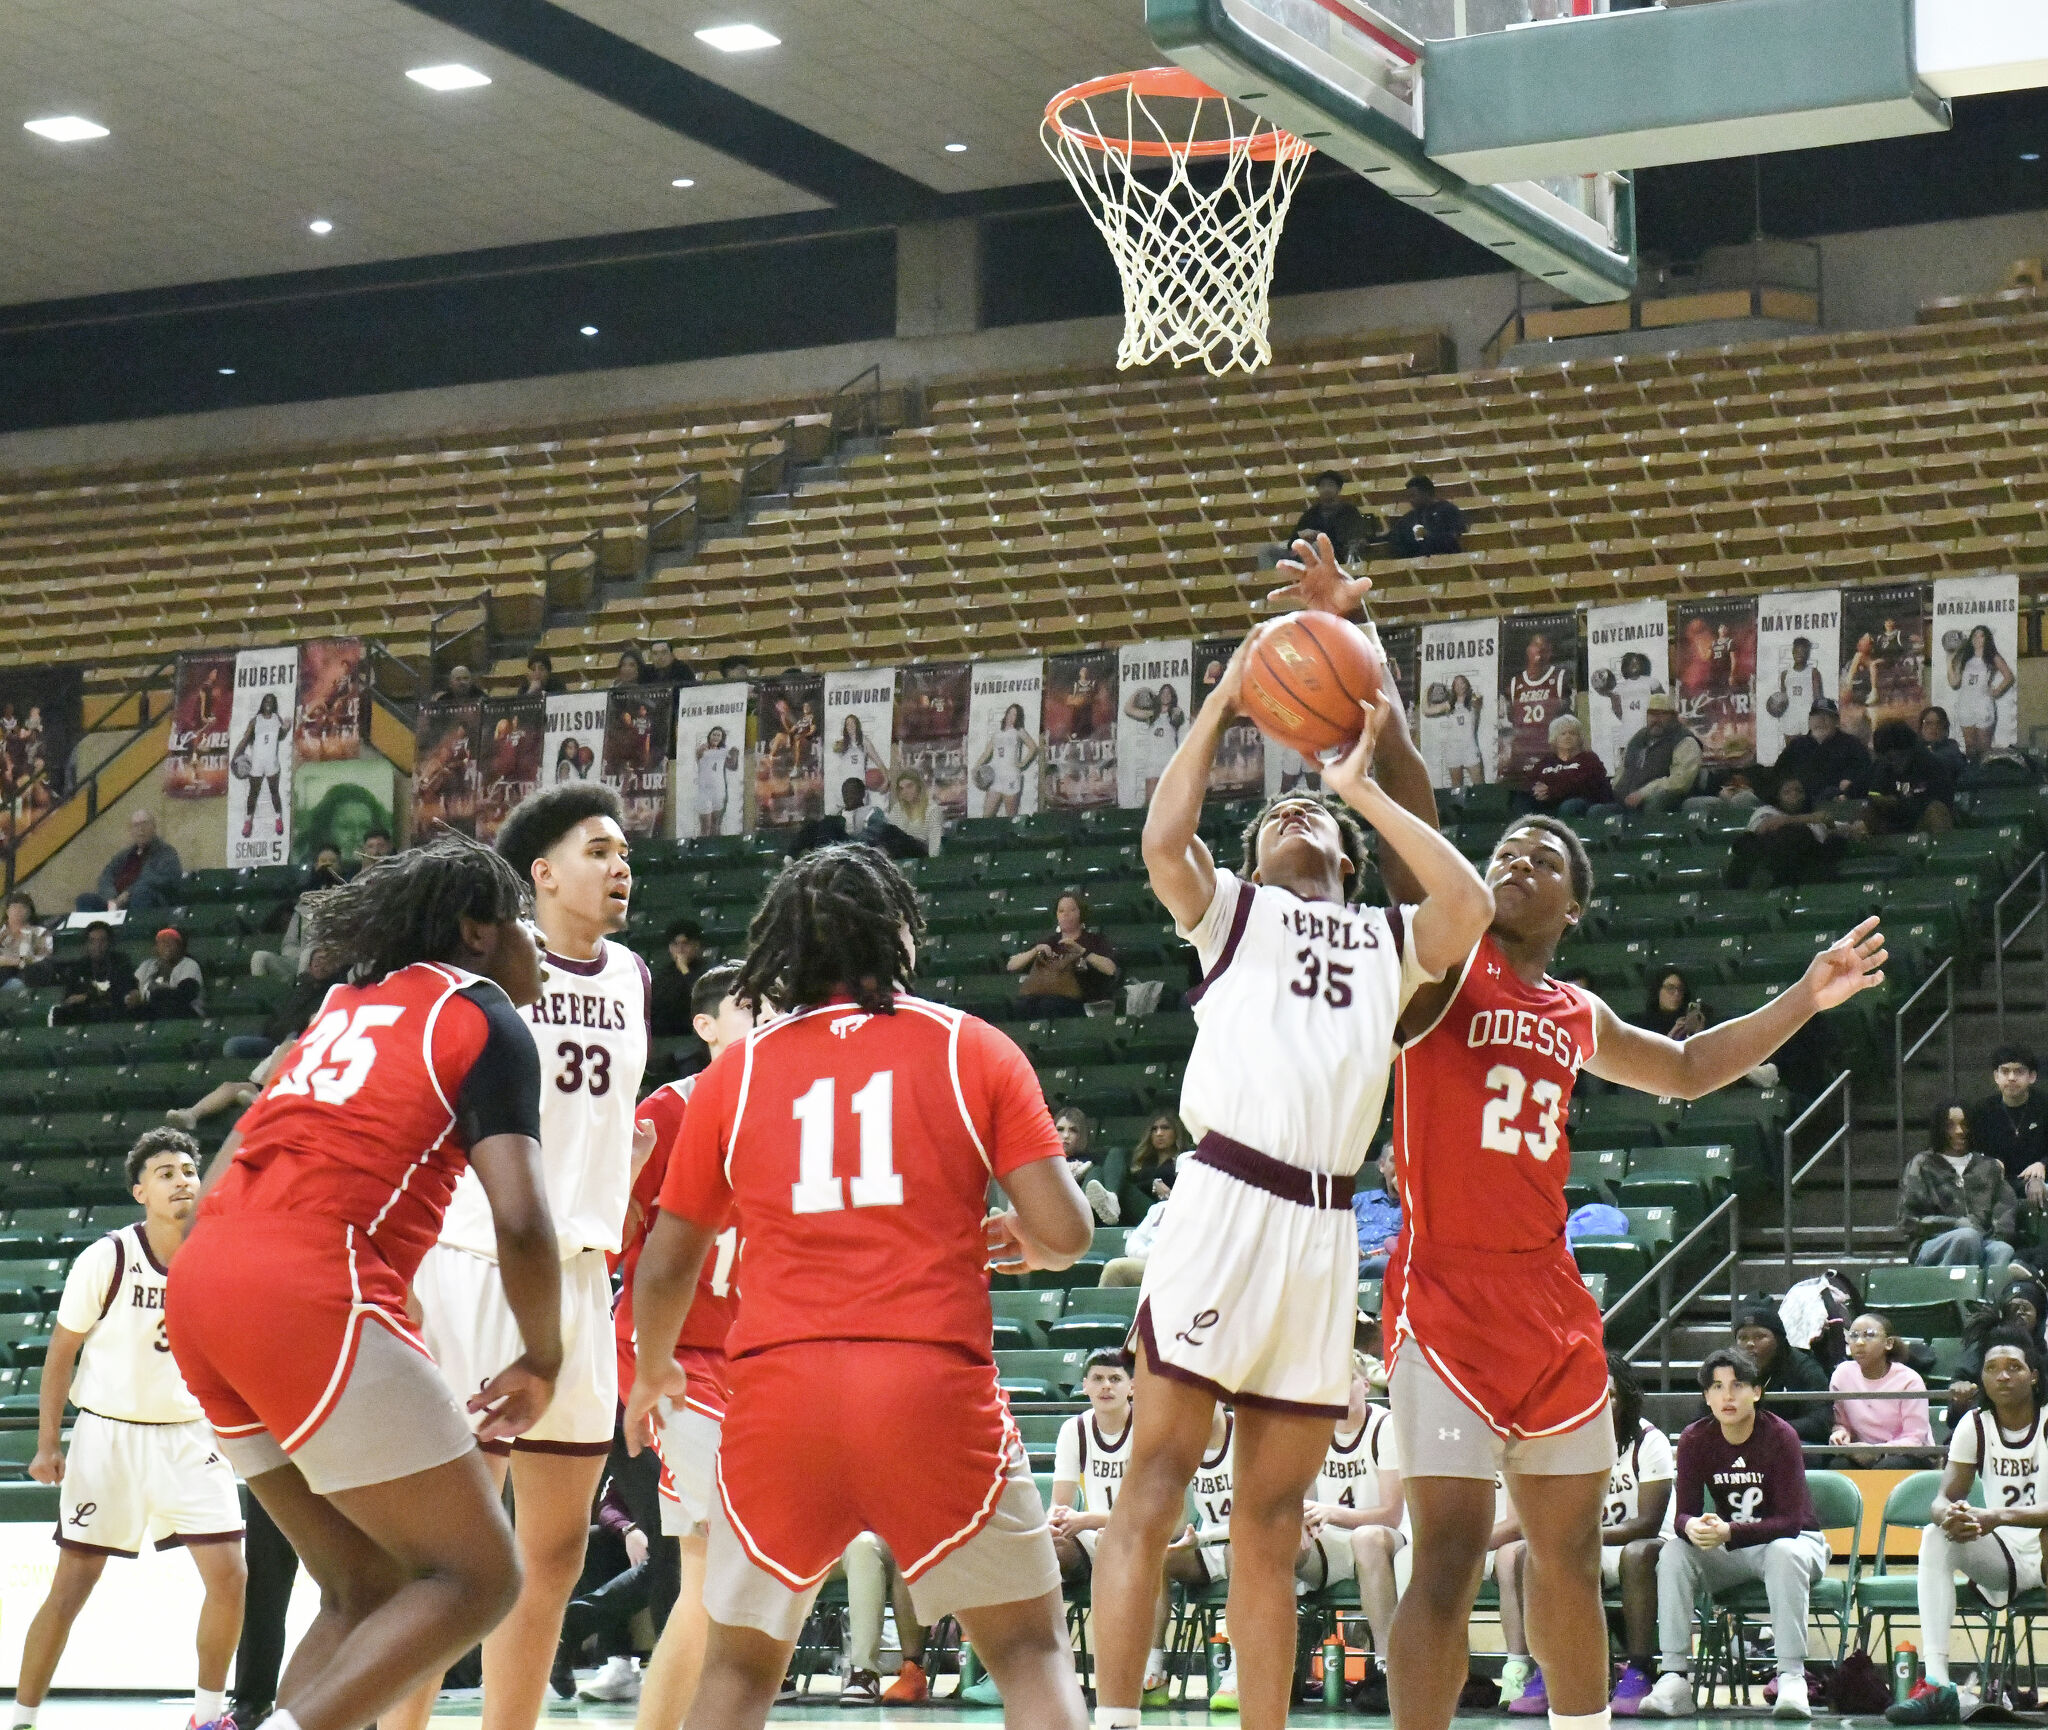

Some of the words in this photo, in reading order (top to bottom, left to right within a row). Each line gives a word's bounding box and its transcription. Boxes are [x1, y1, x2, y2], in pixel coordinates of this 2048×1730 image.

[1937, 599, 2015, 615] MANZANARES
[1592, 623, 1664, 644] ONYEMAIZU
[1761, 612, 1838, 632] MAYBERRY
[1425, 638, 1495, 661] RHOADES
[238, 665, 295, 688] HUBERT
[1122, 659, 1189, 681] PRIMERA
[828, 687, 891, 706] ERDWURM
[974, 678, 1040, 695] VANDERVEER
[545, 709, 605, 732] WILSON
[1522, 705, 1545, 723] 20
[236, 842, 267, 858] SENIOR
[272, 841, 282, 862] 5
[1291, 947, 1354, 1009] 35
[532, 992, 626, 1030] REBELS
[556, 1041, 611, 1096] 33
[1481, 1064, 1563, 1162] 23
[792, 1070, 904, 1215] 11
[1176, 1309, 1219, 1346] L
[1338, 1486, 1356, 1509] 4
[69, 1502, 97, 1527] L
[1205, 1498, 1232, 1524] 14
